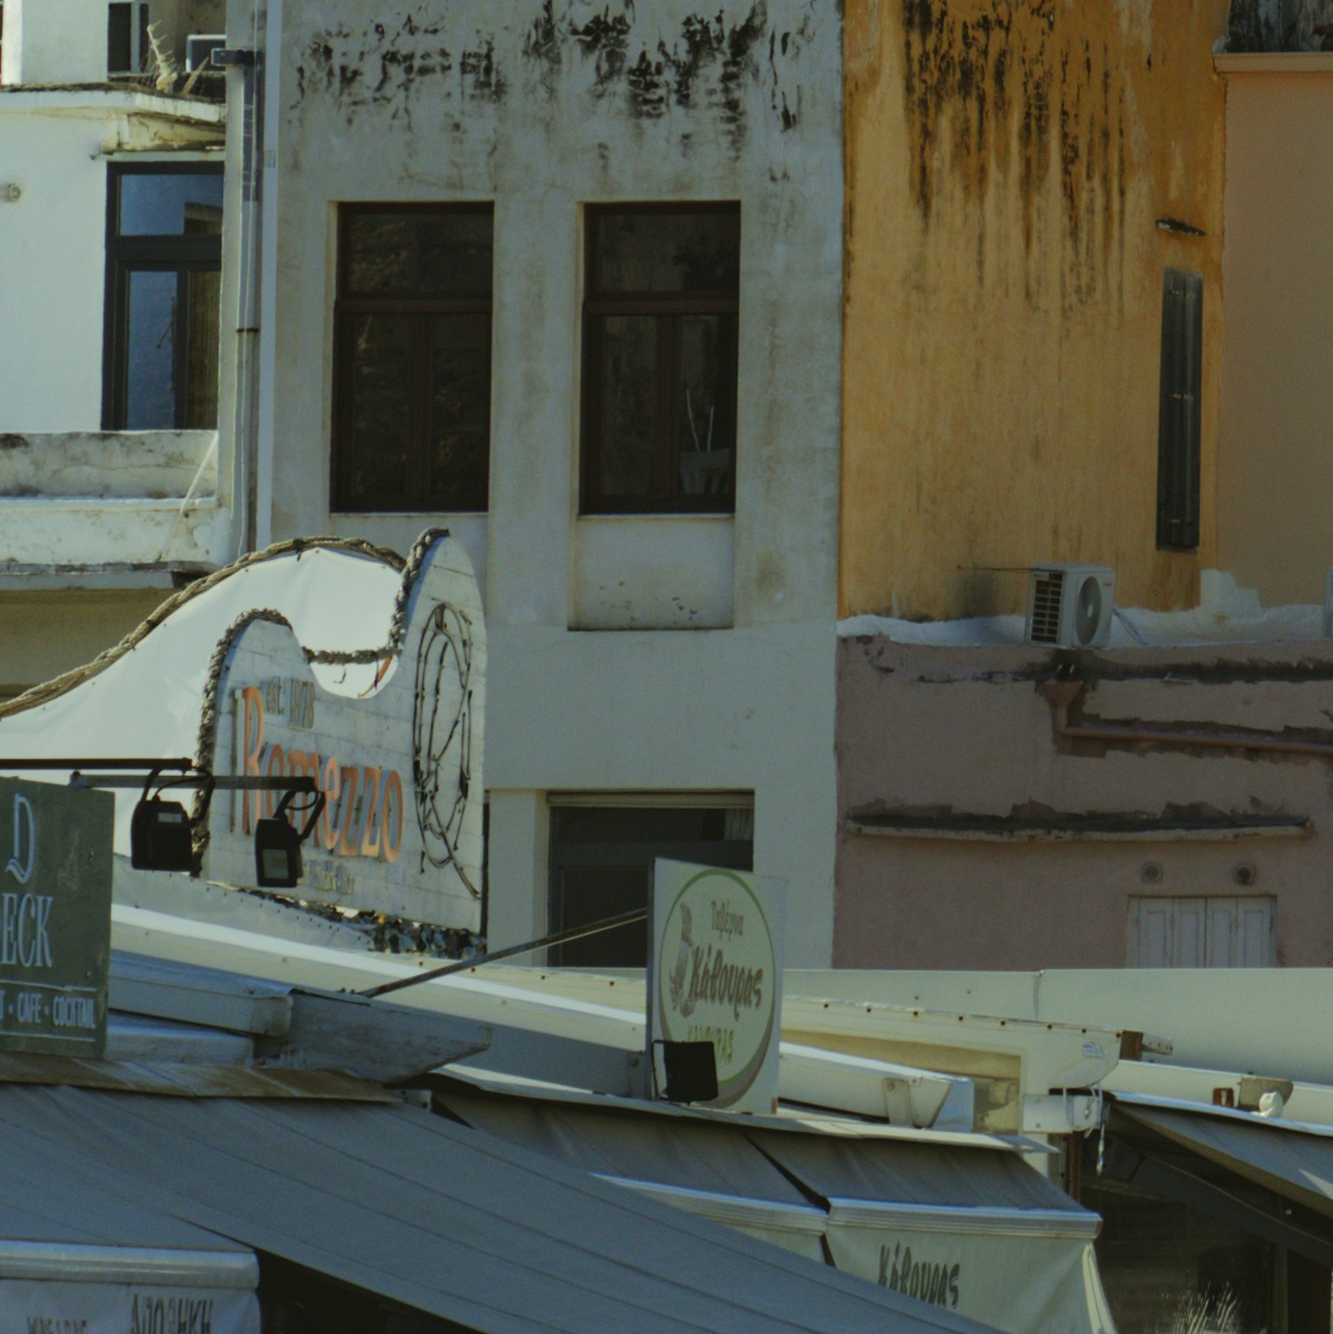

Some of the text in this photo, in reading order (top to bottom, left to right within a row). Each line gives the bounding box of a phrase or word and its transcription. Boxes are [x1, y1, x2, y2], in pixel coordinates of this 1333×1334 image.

[0, 891, 54, 968] ECK
[17, 991, 43, 1024] CAFE
[53, 995, 97, 1029] COCKTAIL
